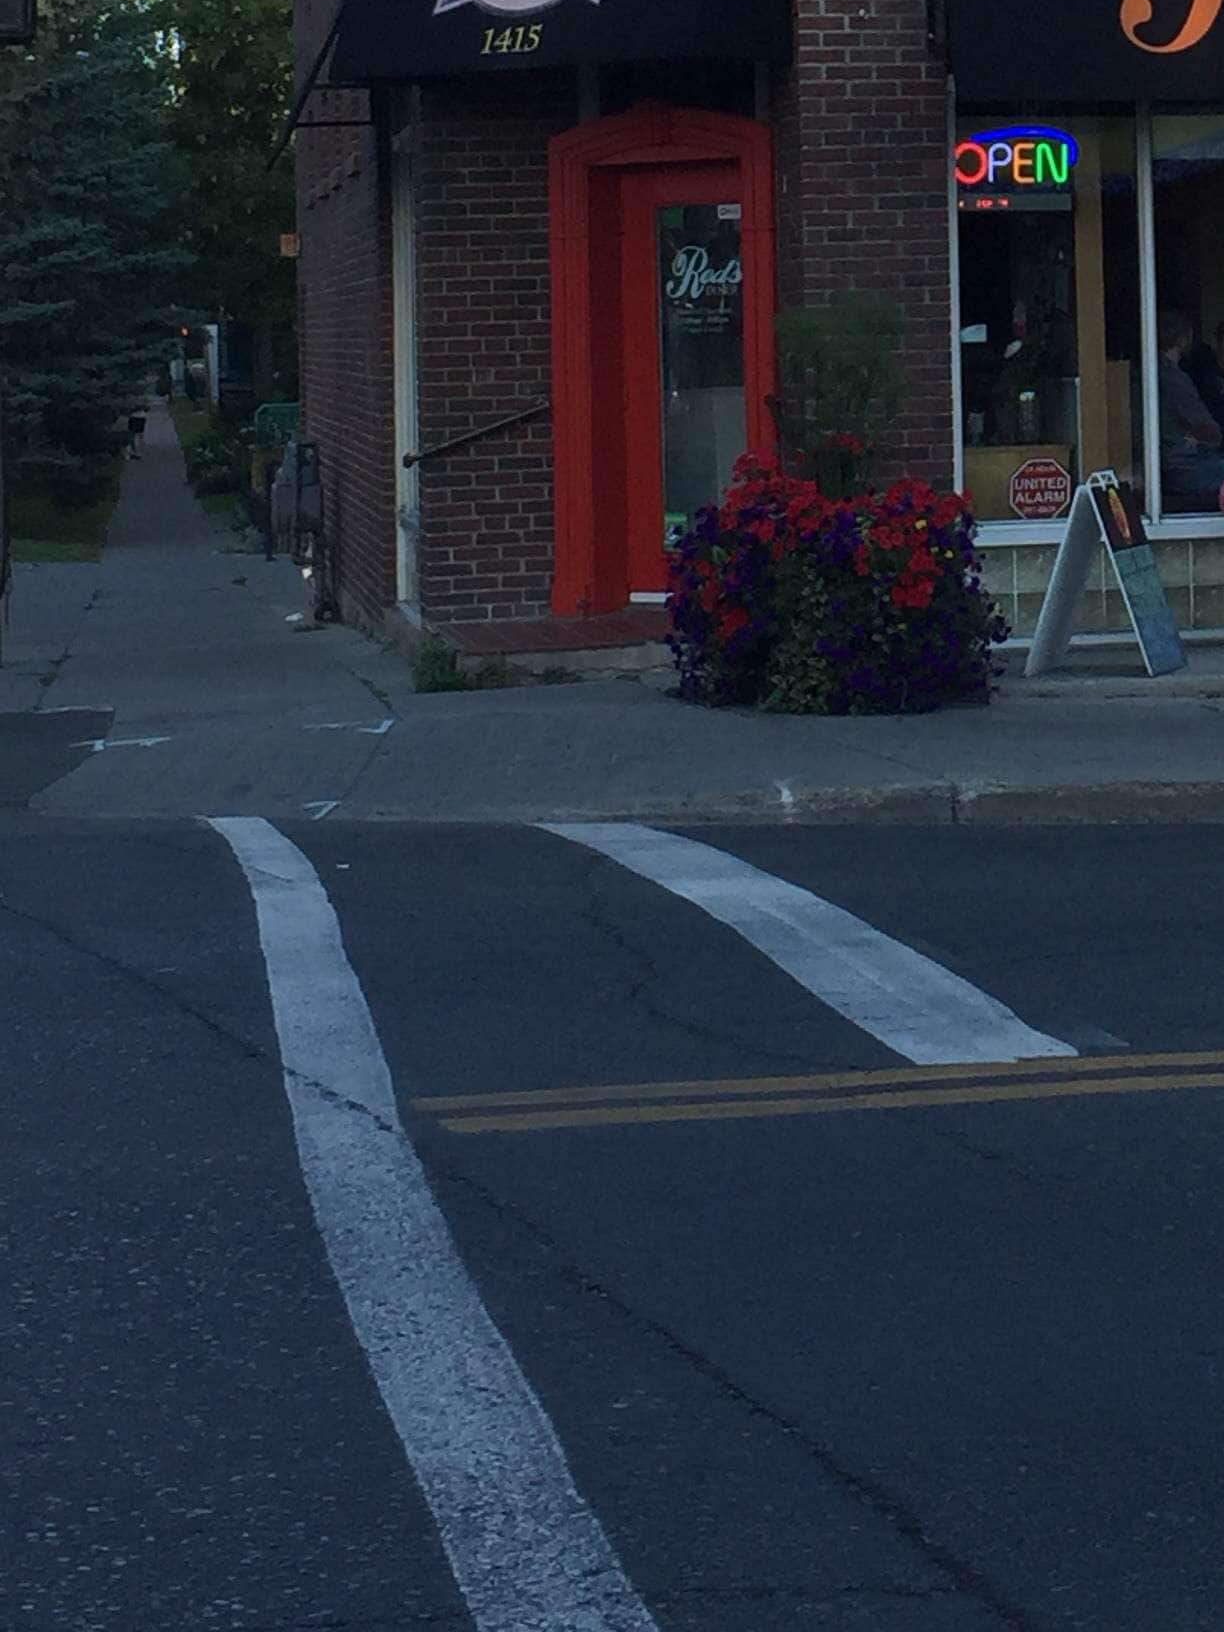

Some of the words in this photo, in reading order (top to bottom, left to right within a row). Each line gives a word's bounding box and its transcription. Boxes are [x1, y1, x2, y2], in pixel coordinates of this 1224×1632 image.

[480, 25, 542, 54] 1415
[954, 141, 1068, 184] OPEN
[1015, 477, 1066, 490] UNITED
[1015, 491, 1065, 504] ALARM
